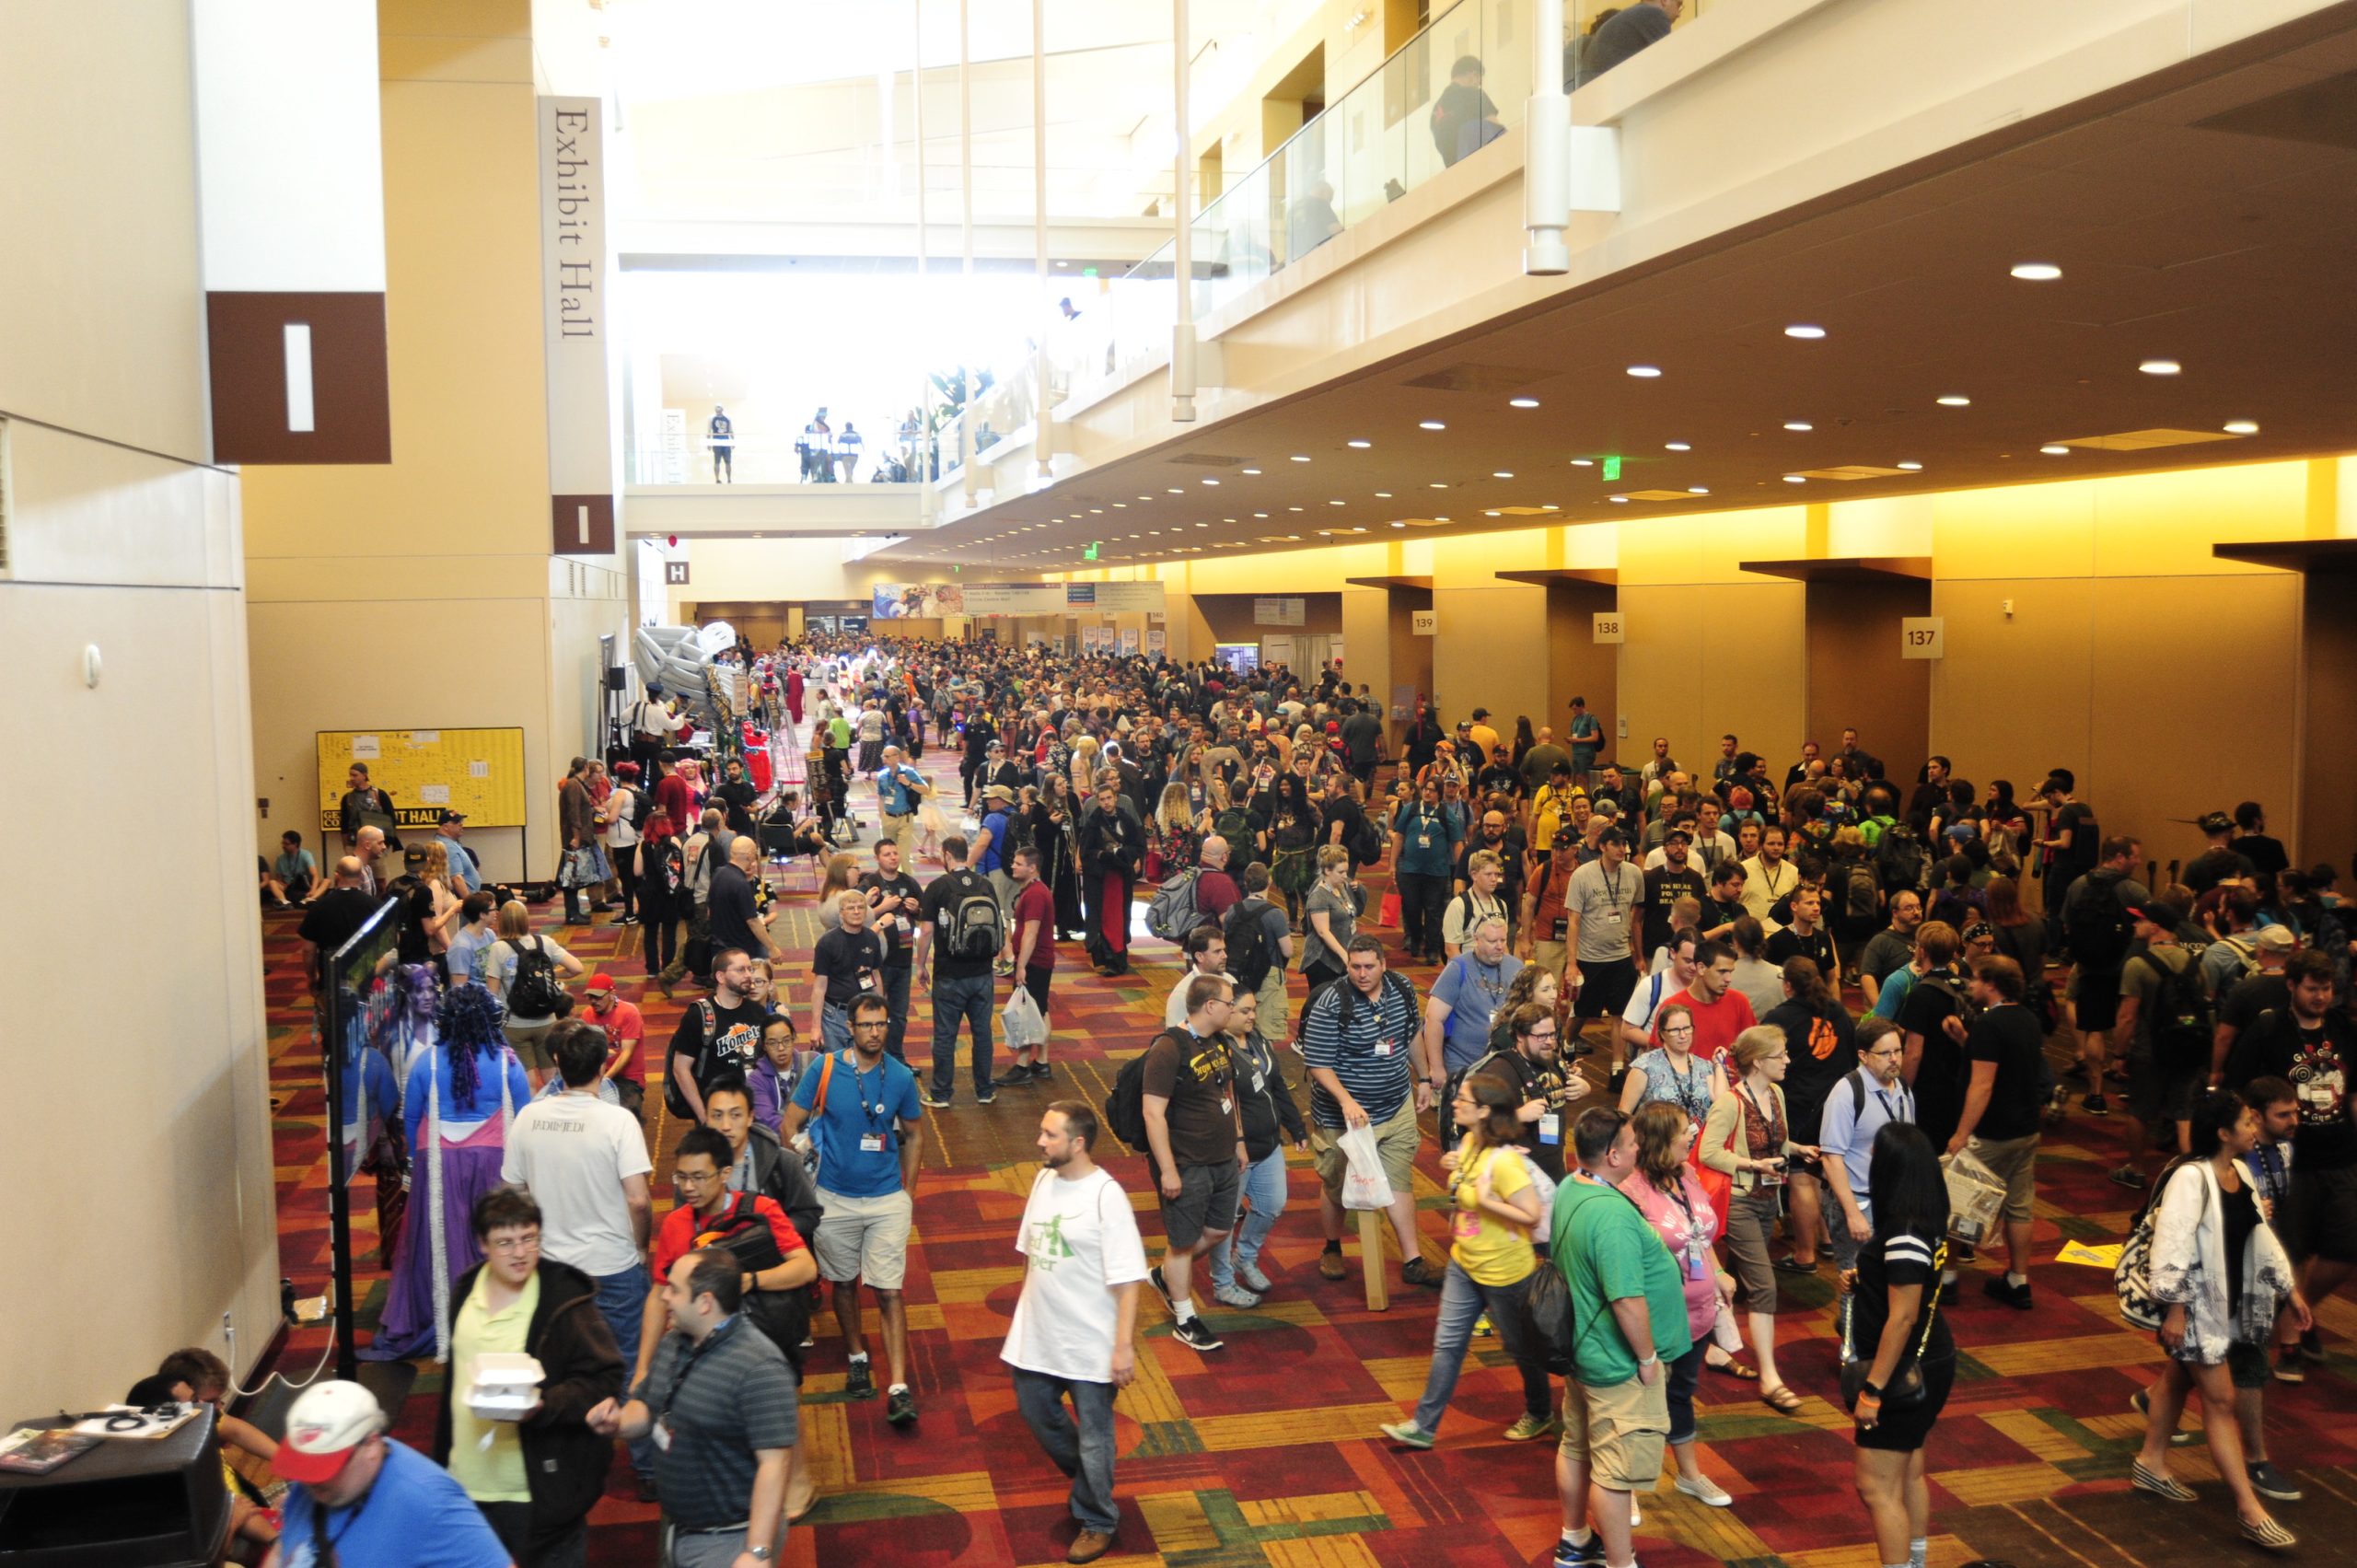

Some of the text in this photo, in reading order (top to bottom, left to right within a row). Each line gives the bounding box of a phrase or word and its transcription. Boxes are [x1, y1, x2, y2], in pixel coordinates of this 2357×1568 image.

[555, 108, 593, 340] Exhibit Hall
[284, 324, 314, 432] I
[577, 505, 589, 544] I
[670, 565, 685, 581] H
[1416, 618, 1433, 627] 139
[1597, 621, 1619, 633] 138
[1907, 630, 1935, 645] 137
[323, 810, 341, 819] GE
[323, 819, 341, 827] CO
